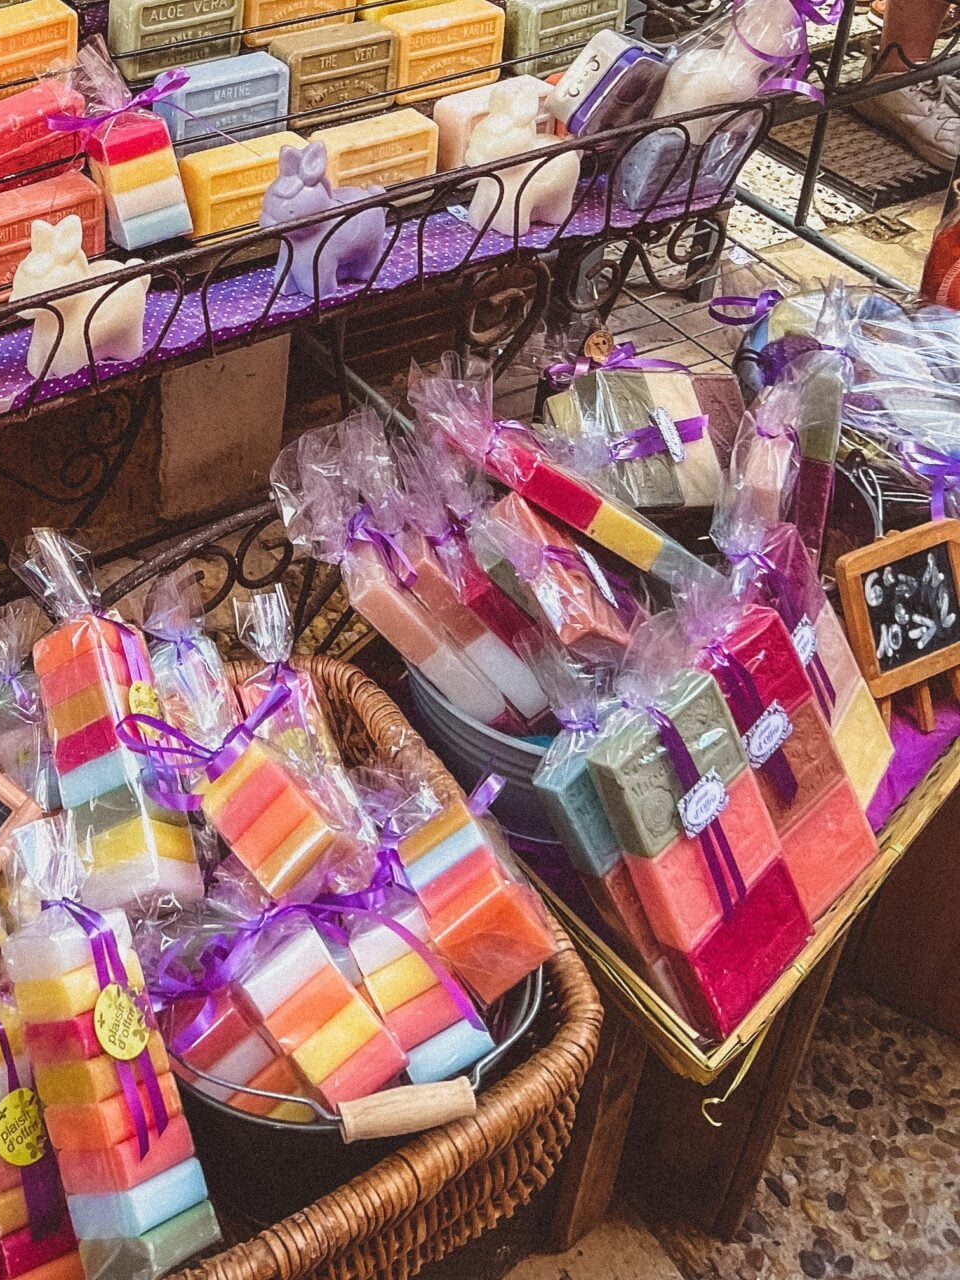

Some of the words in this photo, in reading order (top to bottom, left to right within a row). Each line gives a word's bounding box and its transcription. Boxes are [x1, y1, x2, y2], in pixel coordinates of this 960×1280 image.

[149, 3, 185, 21] ALOE
[318, 55, 338, 69] THE
[352, 46, 379, 61] VERT
[213, 82, 251, 101] MARINE
